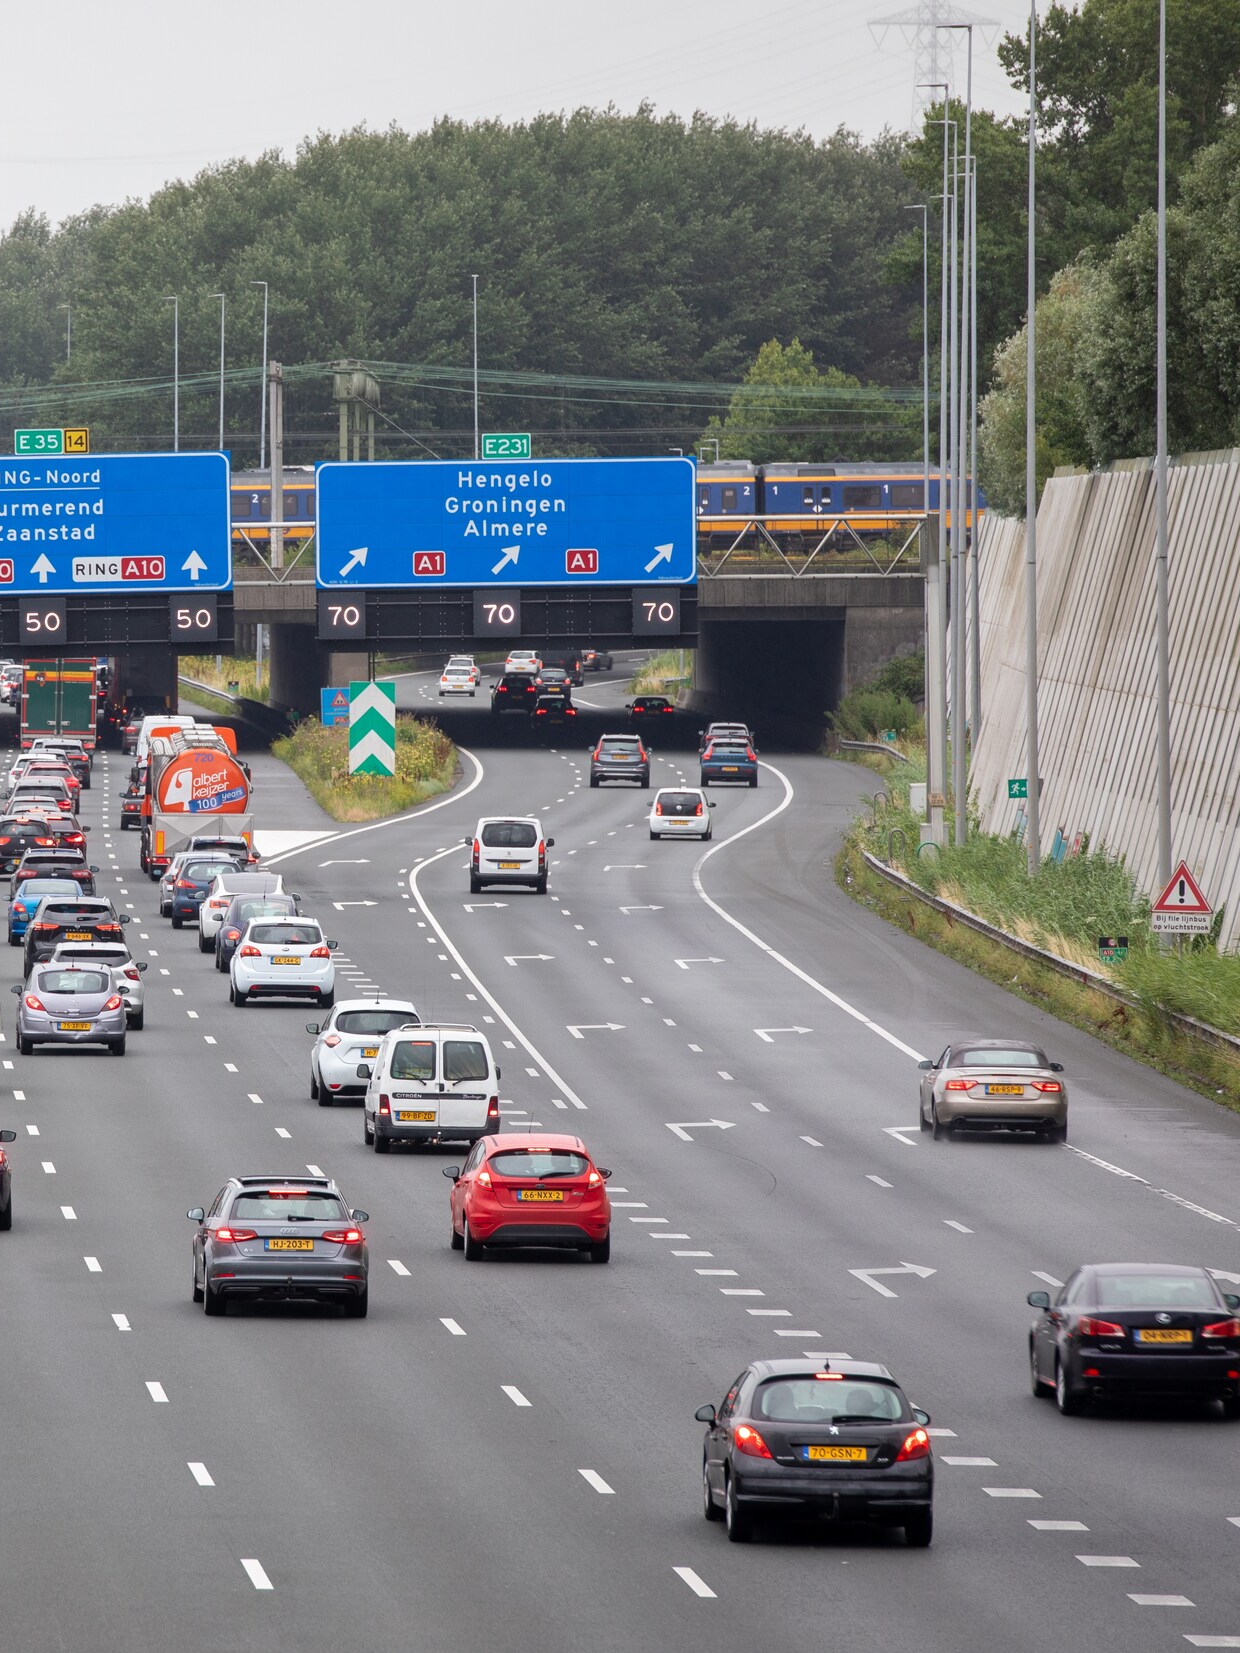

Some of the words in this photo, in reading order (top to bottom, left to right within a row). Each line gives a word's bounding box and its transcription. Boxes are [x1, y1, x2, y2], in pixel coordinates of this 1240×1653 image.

[20, 435, 31, 450] E
[35, 435, 59, 449] 35
[67, 435, 84, 448] 14
[485, 438, 527, 455] E231
[458, 470, 552, 492] Hengelo
[252, 494, 259, 503] 2
[744, 486, 750, 495] 2
[445, 496, 566, 517] Groningen
[464, 519, 548, 538] Almere
[75, 562, 118, 577] RING
[125, 560, 164, 576] A10
[418, 555, 441, 571] A1
[570, 553, 594, 569] A1
[176, 609, 212, 629] 50
[328, 606, 360, 626] 70
[483, 604, 515, 624] 70
[642, 602, 674, 622] 70
[26, 612, 60, 632] 50
[194, 753, 215, 763] 720
[193, 768, 228, 787] albert
[193, 782, 229, 800] keijzer
[197, 799, 217, 810] 100
[221, 788, 244, 803] years
[1156, 915, 1166, 923] Bij
[1181, 916, 1207, 924] lijnbus
[1164, 923, 1209, 931] vluchtstrook
[990, 1085, 1022, 1093] 46-RSP-9
[401, 1111, 433, 1120] 99-BF-ZD
[523, 1190, 561, 1199] 66-NXX-2
[272, 1239, 311, 1249] HJ-203-T
[811, 1447, 863, 1459] 70-GSN-7
